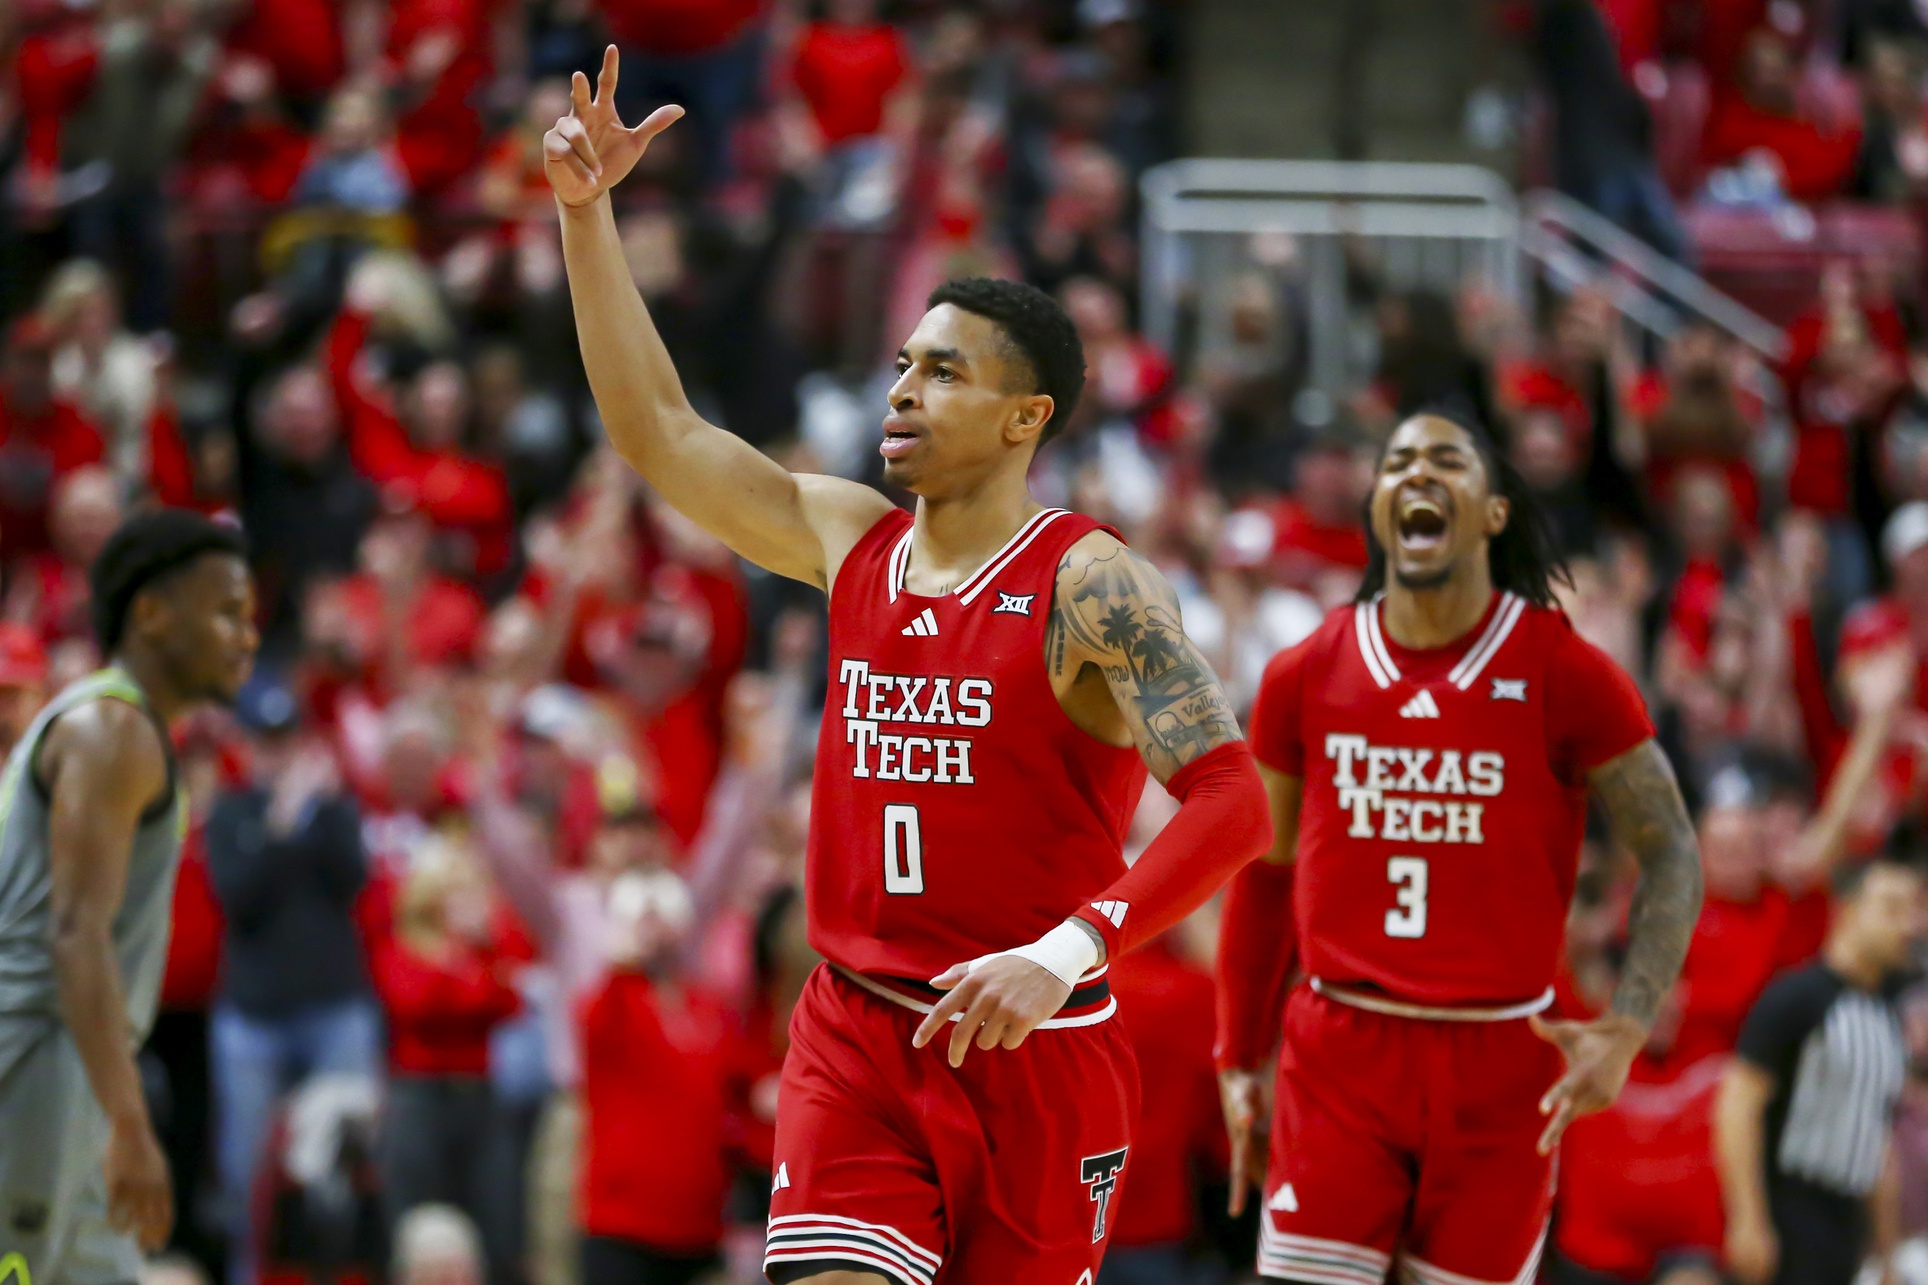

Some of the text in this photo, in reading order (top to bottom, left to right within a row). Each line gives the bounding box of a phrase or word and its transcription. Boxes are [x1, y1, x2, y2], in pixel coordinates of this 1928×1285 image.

[990, 589, 1038, 617] XII
[839, 659, 994, 727] TEXAS
[846, 719, 975, 784] TECH
[1325, 732, 1505, 796] TEXAS
[1338, 787, 1485, 844] TECH
[883, 802, 924, 895] 0
[1384, 855, 1428, 938] 3
